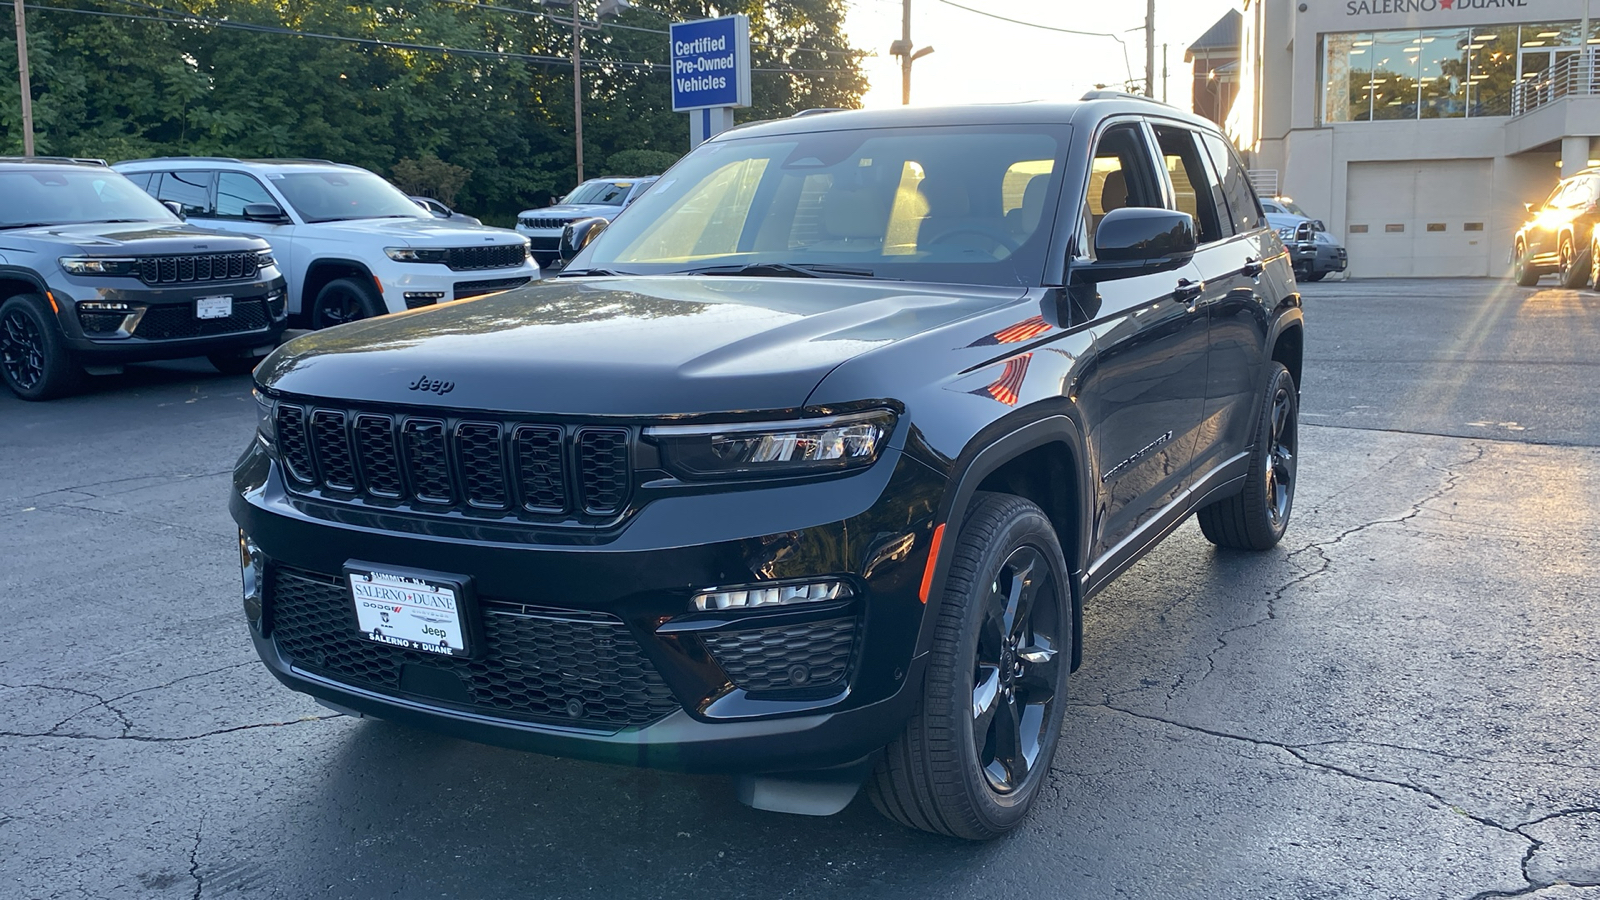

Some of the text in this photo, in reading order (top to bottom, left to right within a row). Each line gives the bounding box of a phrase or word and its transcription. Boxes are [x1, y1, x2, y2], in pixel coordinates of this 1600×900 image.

[1346, 0, 1437, 16] SALERNO
[675, 35, 725, 56] Certified
[676, 53, 733, 74] Pre-Owned
[677, 75, 727, 93] Vehicles
[408, 374, 455, 396] Jeep
[355, 584, 455, 610] SALERNO DUANE
[421, 624, 447, 639] Jeep
[369, 633, 454, 656] SALERNO DUANE
